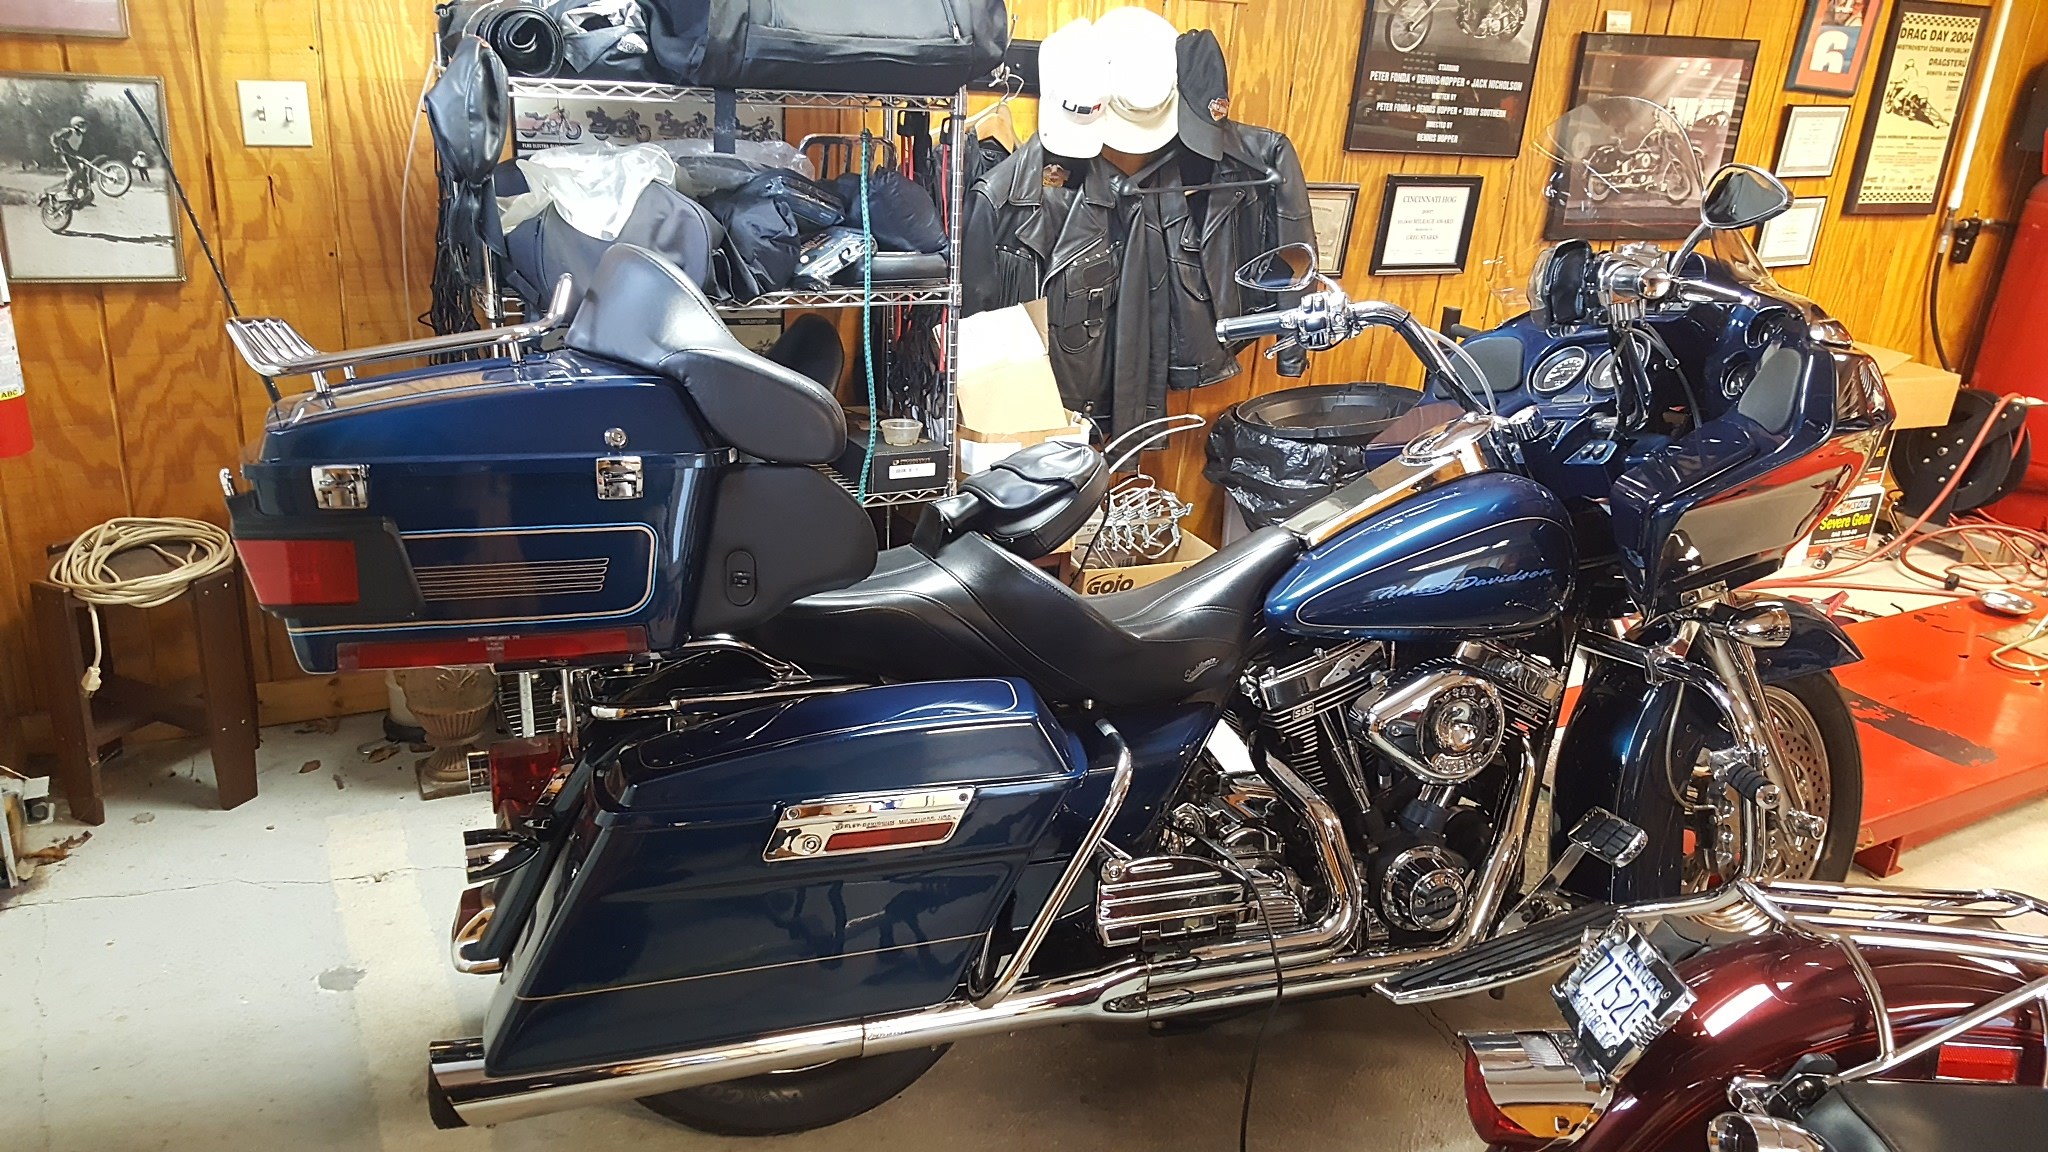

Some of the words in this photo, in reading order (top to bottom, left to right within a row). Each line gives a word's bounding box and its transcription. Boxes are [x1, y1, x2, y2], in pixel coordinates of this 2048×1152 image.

[1900, 27, 1927, 40] DRAG
[1929, 29, 1950, 42] DAY
[1950, 31, 1974, 43] 2004
[1369, 70, 1389, 82] PETER
[1390, 72, 1411, 83] FONDA
[1416, 74, 1440, 86] DENNIS
[1440, 76, 1466, 87] HOPPER
[1470, 79, 1488, 89] JACK
[1488, 79, 1523, 92] NICHOLSON
[1450, 93, 1457, 102] BY
[1062, 99, 1102, 115] USA
[1376, 102, 1393, 112] PETER
[1393, 103, 1411, 112] FONDA
[1415, 105, 1436, 114] DENNIS
[1436, 106, 1458, 115] HOPPER
[1462, 107, 1479, 116] TERRY
[1480, 108, 1507, 118] SOUTHERN
[1446, 121, 1453, 130] BY
[1416, 133, 1437, 142] DENNIS
[1436, 134, 1459, 143] HOPPER
[1, 389, 18, 398] ABC
[1820, 514, 1851, 531] Severe
[1851, 512, 1873, 527] Gear
[1374, 568, 1552, 600] Harley-Davidson
[1294, 704, 1314, 718] S&S
[1521, 704, 1537, 715] S&S
[1621, 949, 1663, 1003] KENTUCK
